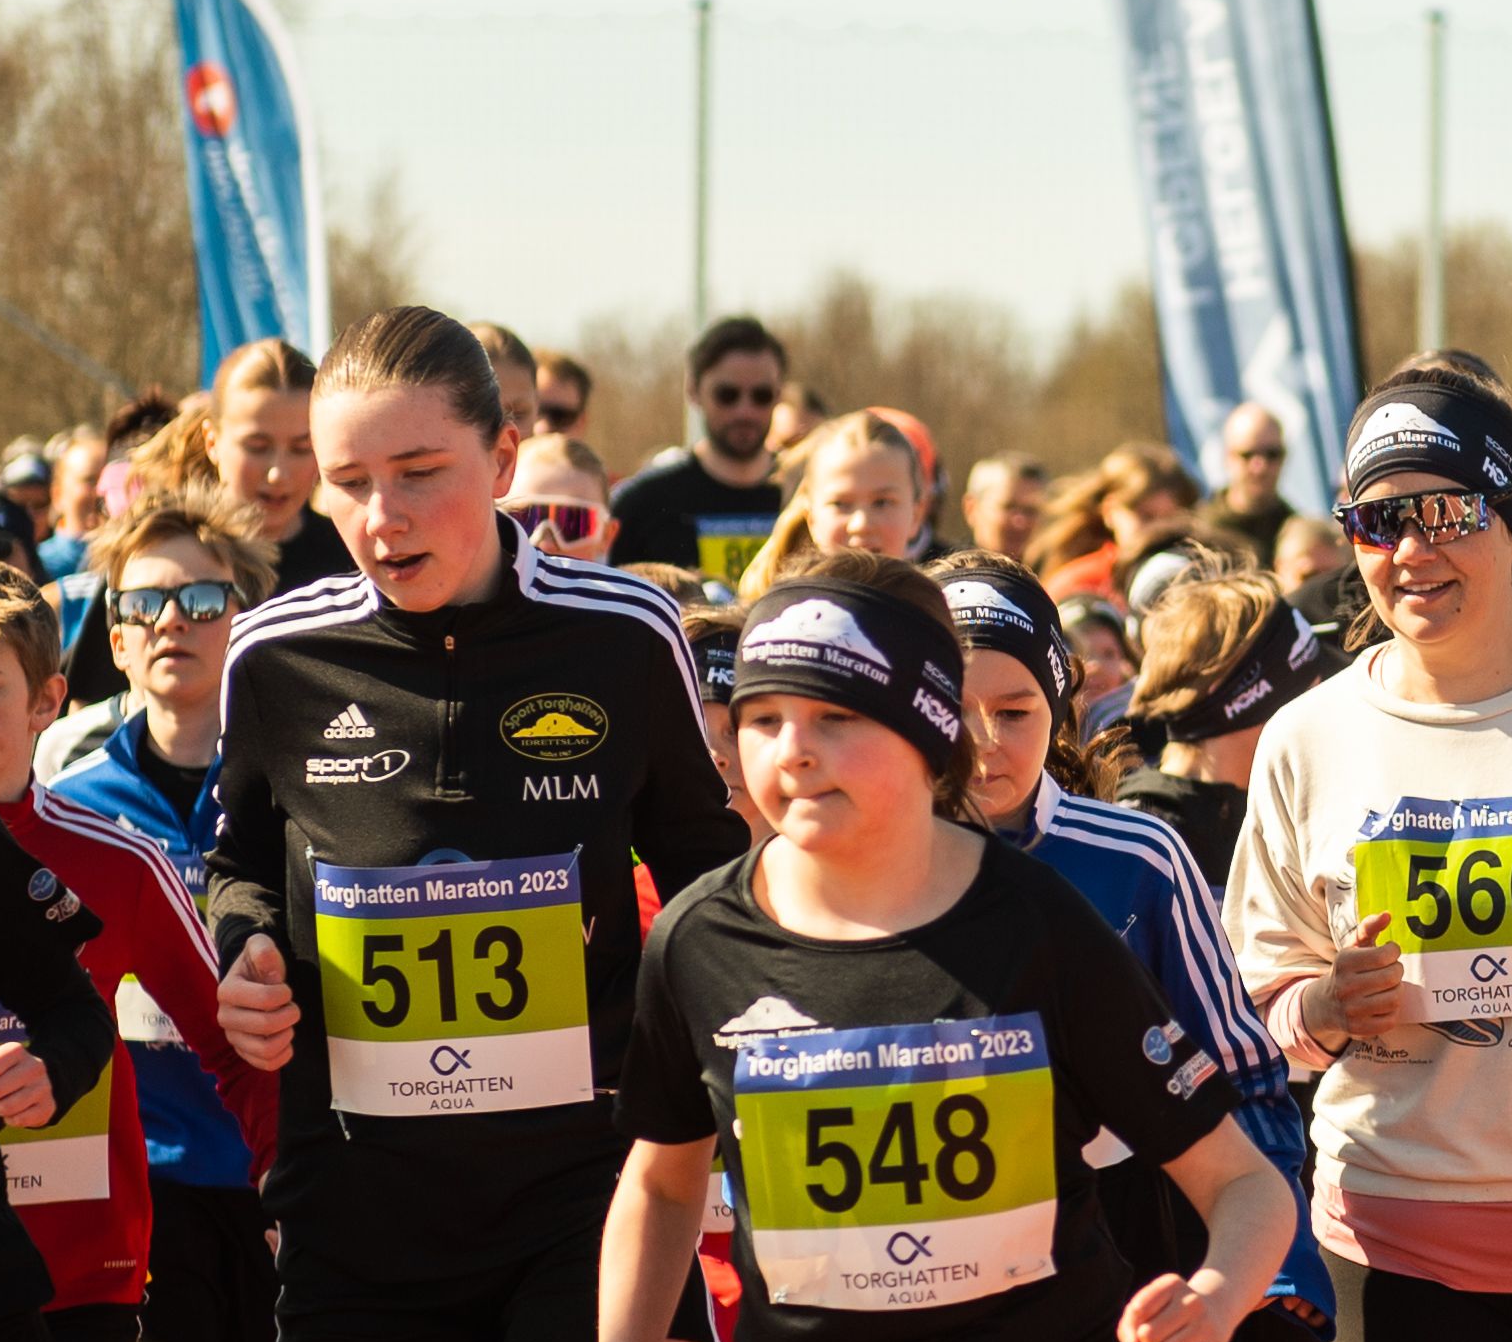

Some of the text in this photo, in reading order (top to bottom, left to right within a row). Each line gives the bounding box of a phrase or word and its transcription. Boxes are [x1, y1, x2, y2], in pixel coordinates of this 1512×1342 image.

[1398, 431, 1461, 452] Maraton
[975, 606, 1034, 635] Maraton
[742, 643, 890, 686] Torghatten Maraton
[1046, 644, 1067, 697] HOKA
[505, 697, 604, 730] Sport Torghatten
[1224, 679, 1273, 720] HOKA
[912, 688, 960, 742] HOKA
[324, 726, 375, 739] adidas
[306, 756, 373, 775] sport
[522, 775, 600, 802] MLM
[1386, 805, 1465, 833] ghatten
[317, 870, 569, 910] Torghatten Maraton 2023
[360, 925, 530, 1030] 513
[1470, 1002, 1512, 1016] AQUA
[746, 1030, 1034, 1080] Torghatten Maraton 2023
[388, 1075, 514, 1099] TORGHATTEN
[430, 1097, 475, 1113] AQUA
[804, 1093, 996, 1215] 548
[840, 1262, 980, 1292] TORGHATTEN
[887, 1287, 939, 1306] AQUA
